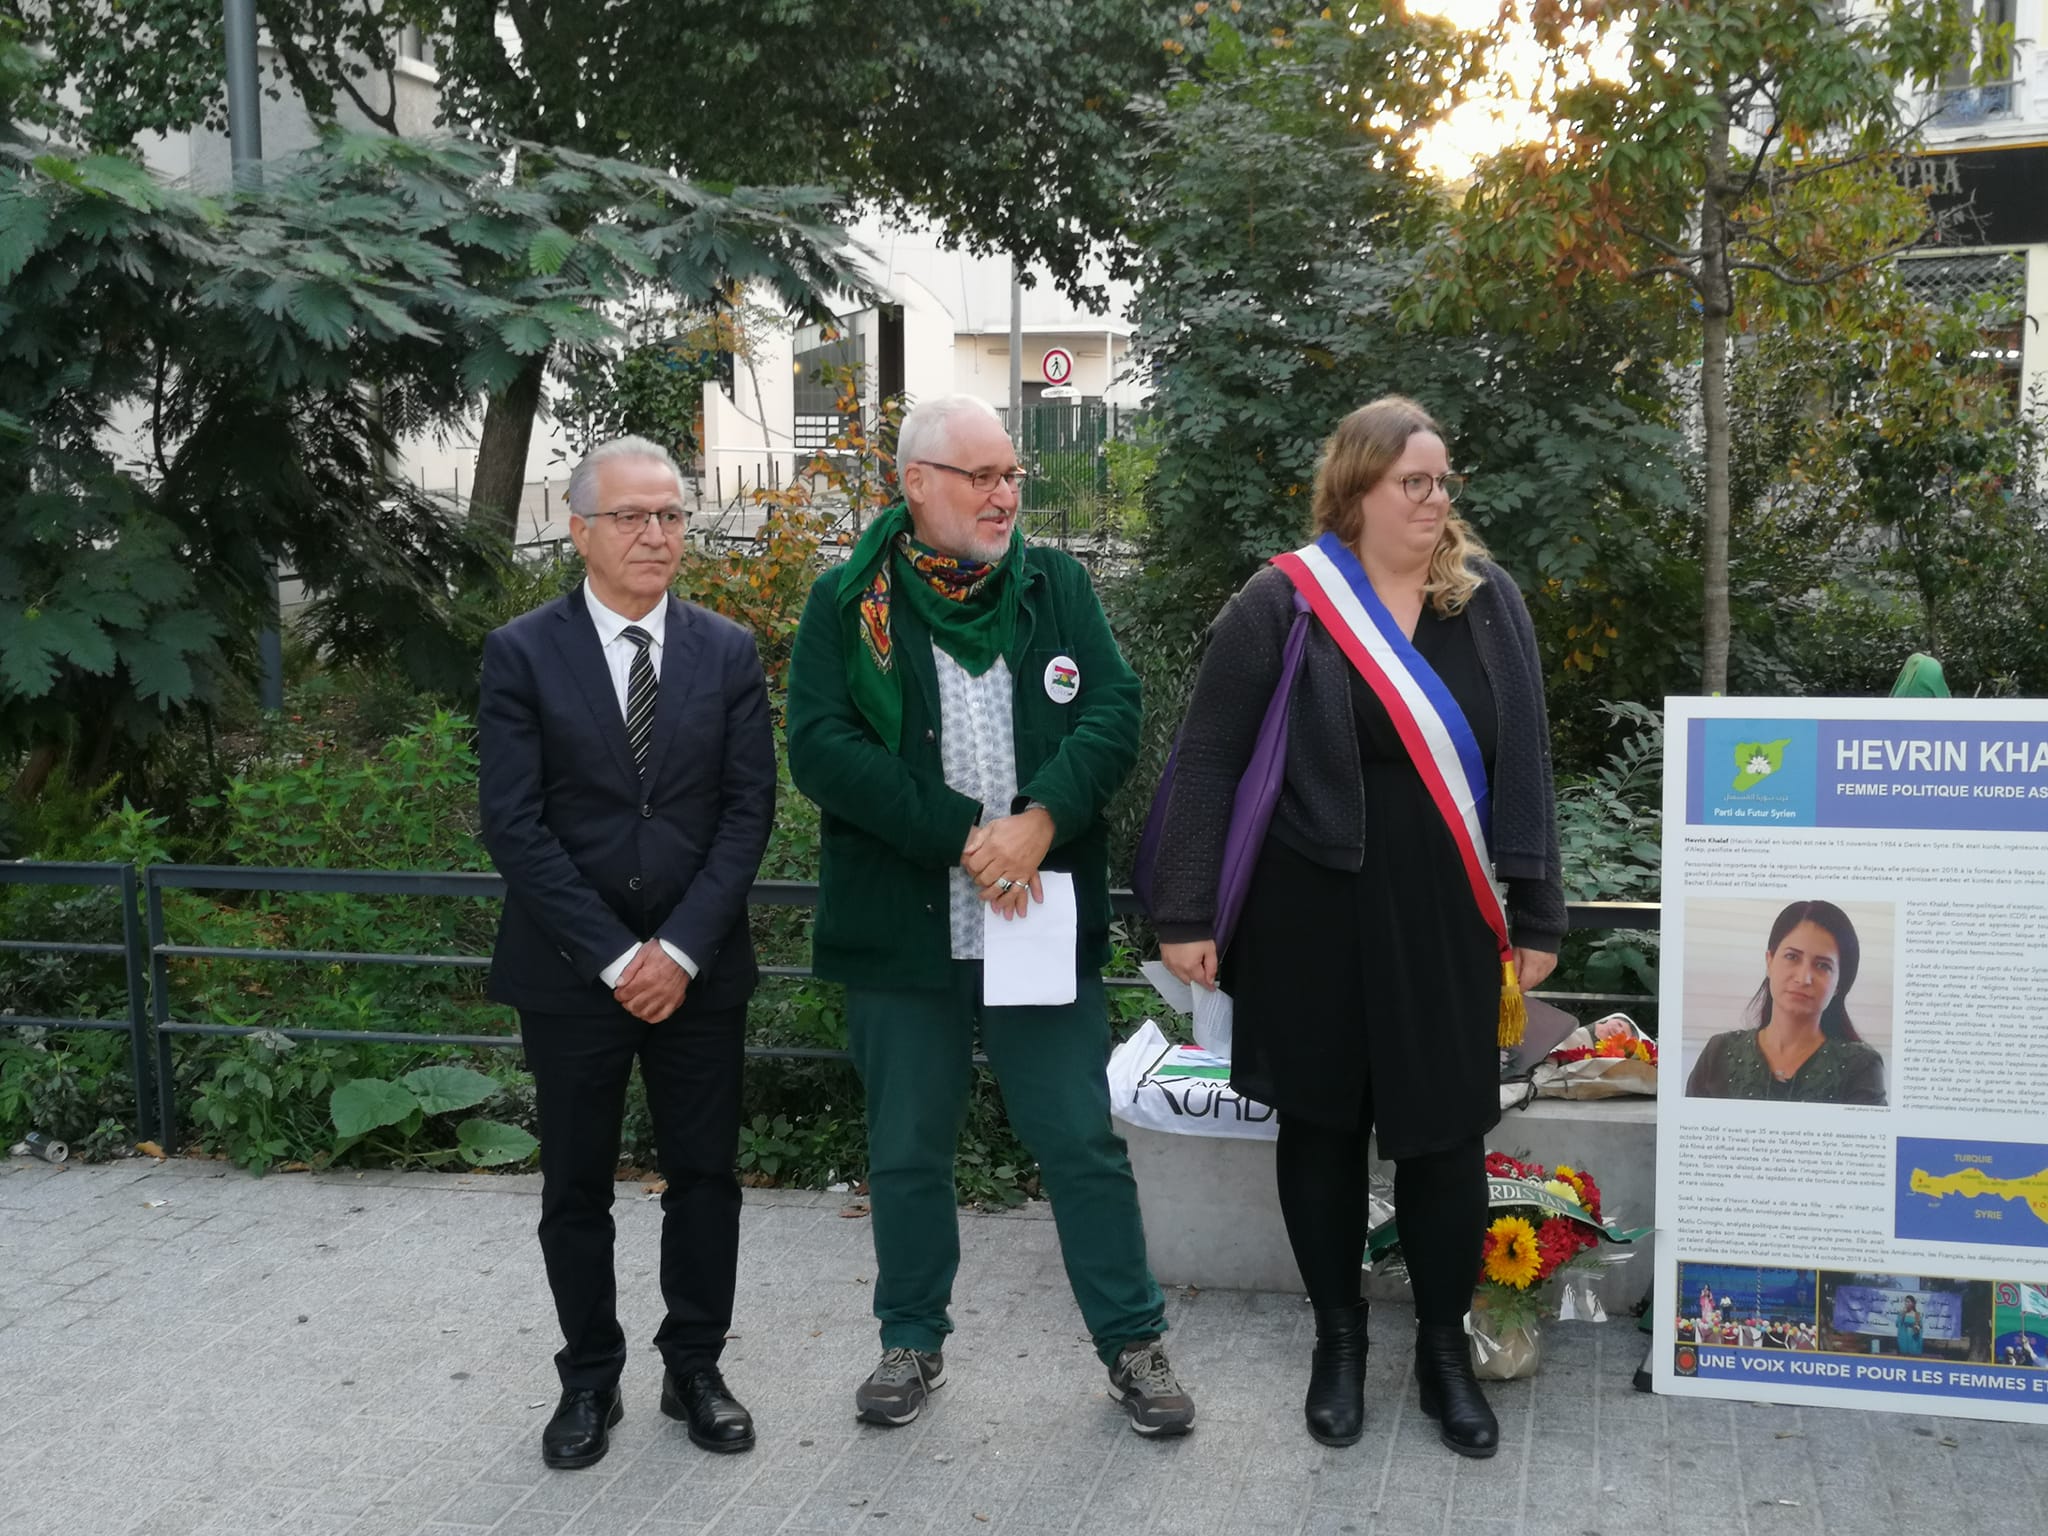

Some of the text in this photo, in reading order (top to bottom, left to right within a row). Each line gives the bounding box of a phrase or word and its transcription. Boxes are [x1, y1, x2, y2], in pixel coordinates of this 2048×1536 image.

[1836, 739, 2048, 773] HEVRIN KHA
[1836, 783, 2048, 799] FEMME POLITIQUE KURDE AS
[1714, 807, 1796, 819] Parti du Futur Syrien
[1131, 1078, 1275, 1122] KURD
[1953, 1153, 1993, 1163] TURQUIE
[1489, 1184, 1569, 1212] RDISTAN
[1975, 1209, 2003, 1220] SYRIE
[1700, 1353, 1736, 1369] UNE
[1741, 1357, 1785, 1373] VOIX
[1790, 1360, 1850, 1378] KURDE
[1856, 1365, 1907, 1382] POUR
[1912, 1369, 1943, 1384] LES
[1949, 1372, 2026, 1390] FEMMES
